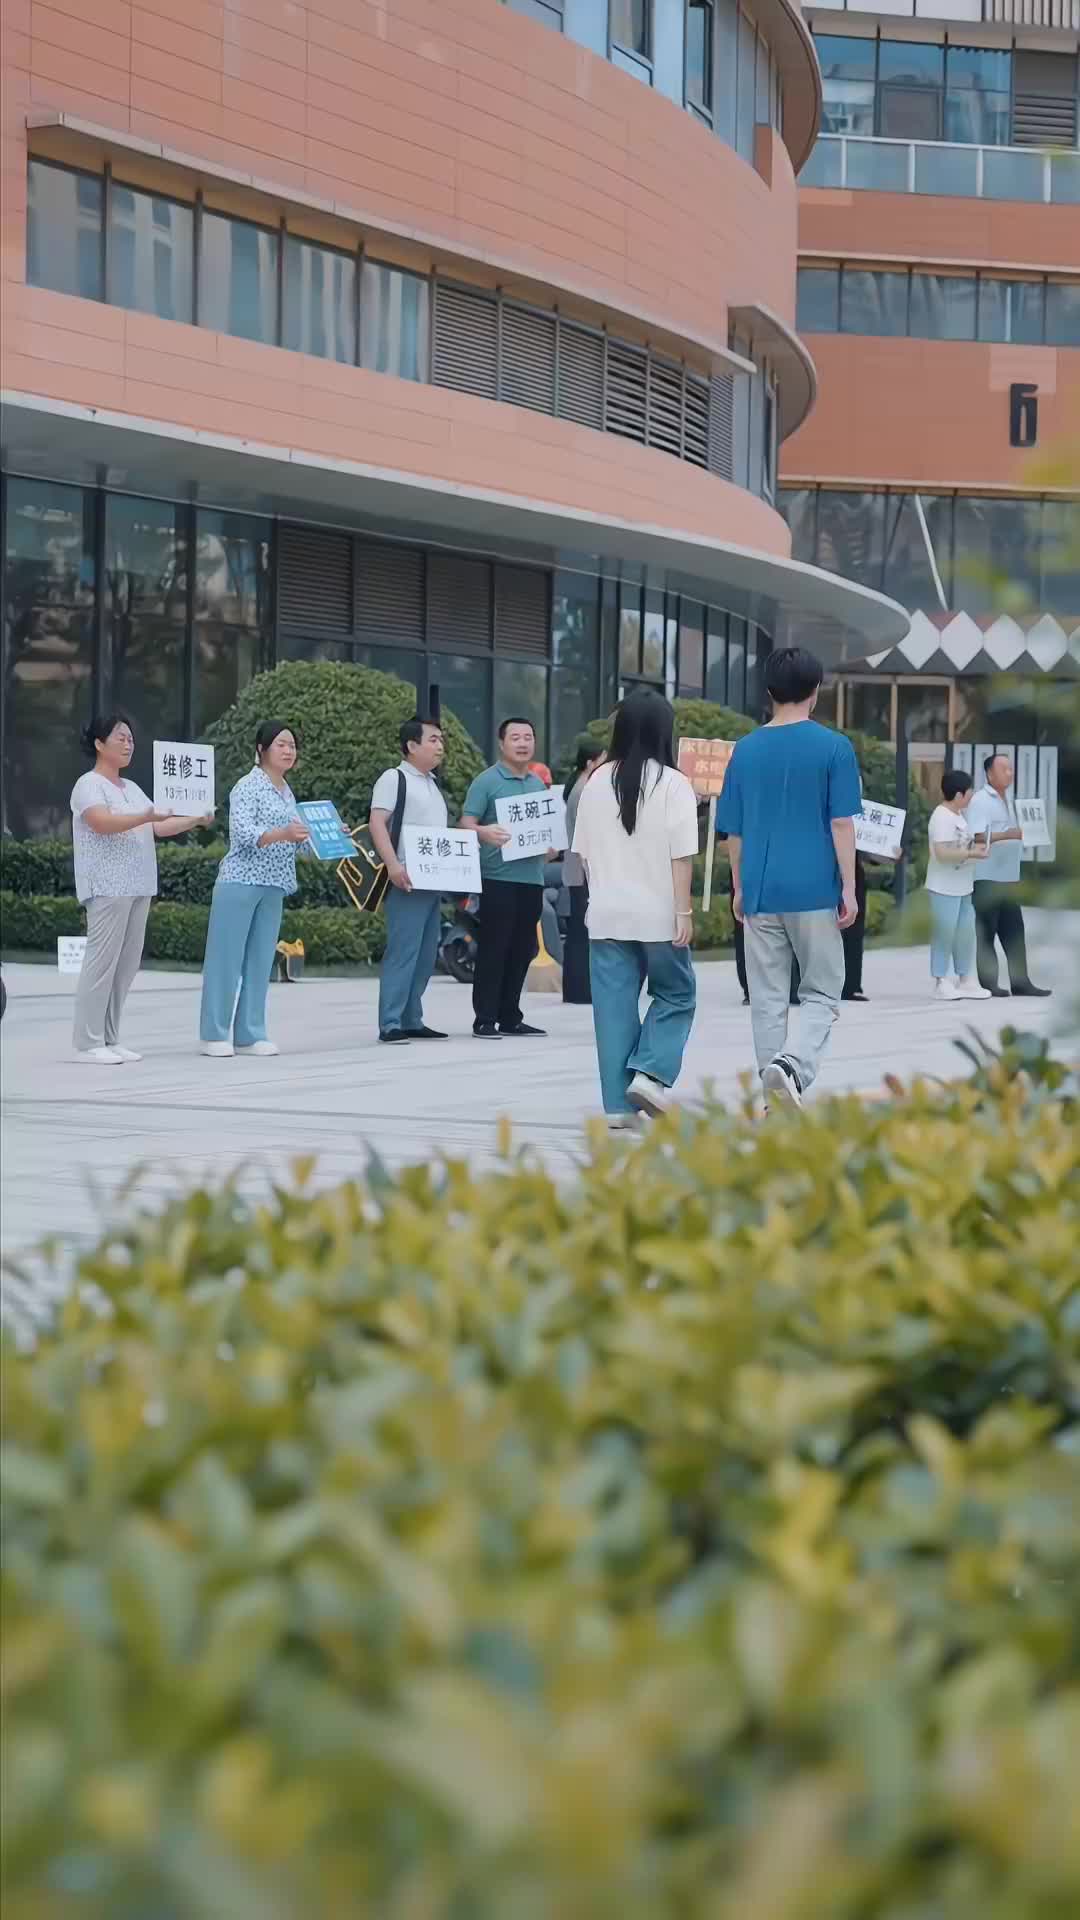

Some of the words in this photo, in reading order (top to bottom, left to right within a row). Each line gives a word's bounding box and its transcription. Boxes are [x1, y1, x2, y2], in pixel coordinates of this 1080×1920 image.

[1010, 383, 1038, 447] 6
[163, 753, 208, 779] 维修工
[508, 799, 556, 823] 洗碗工
[418, 836, 471, 857] 装修工
